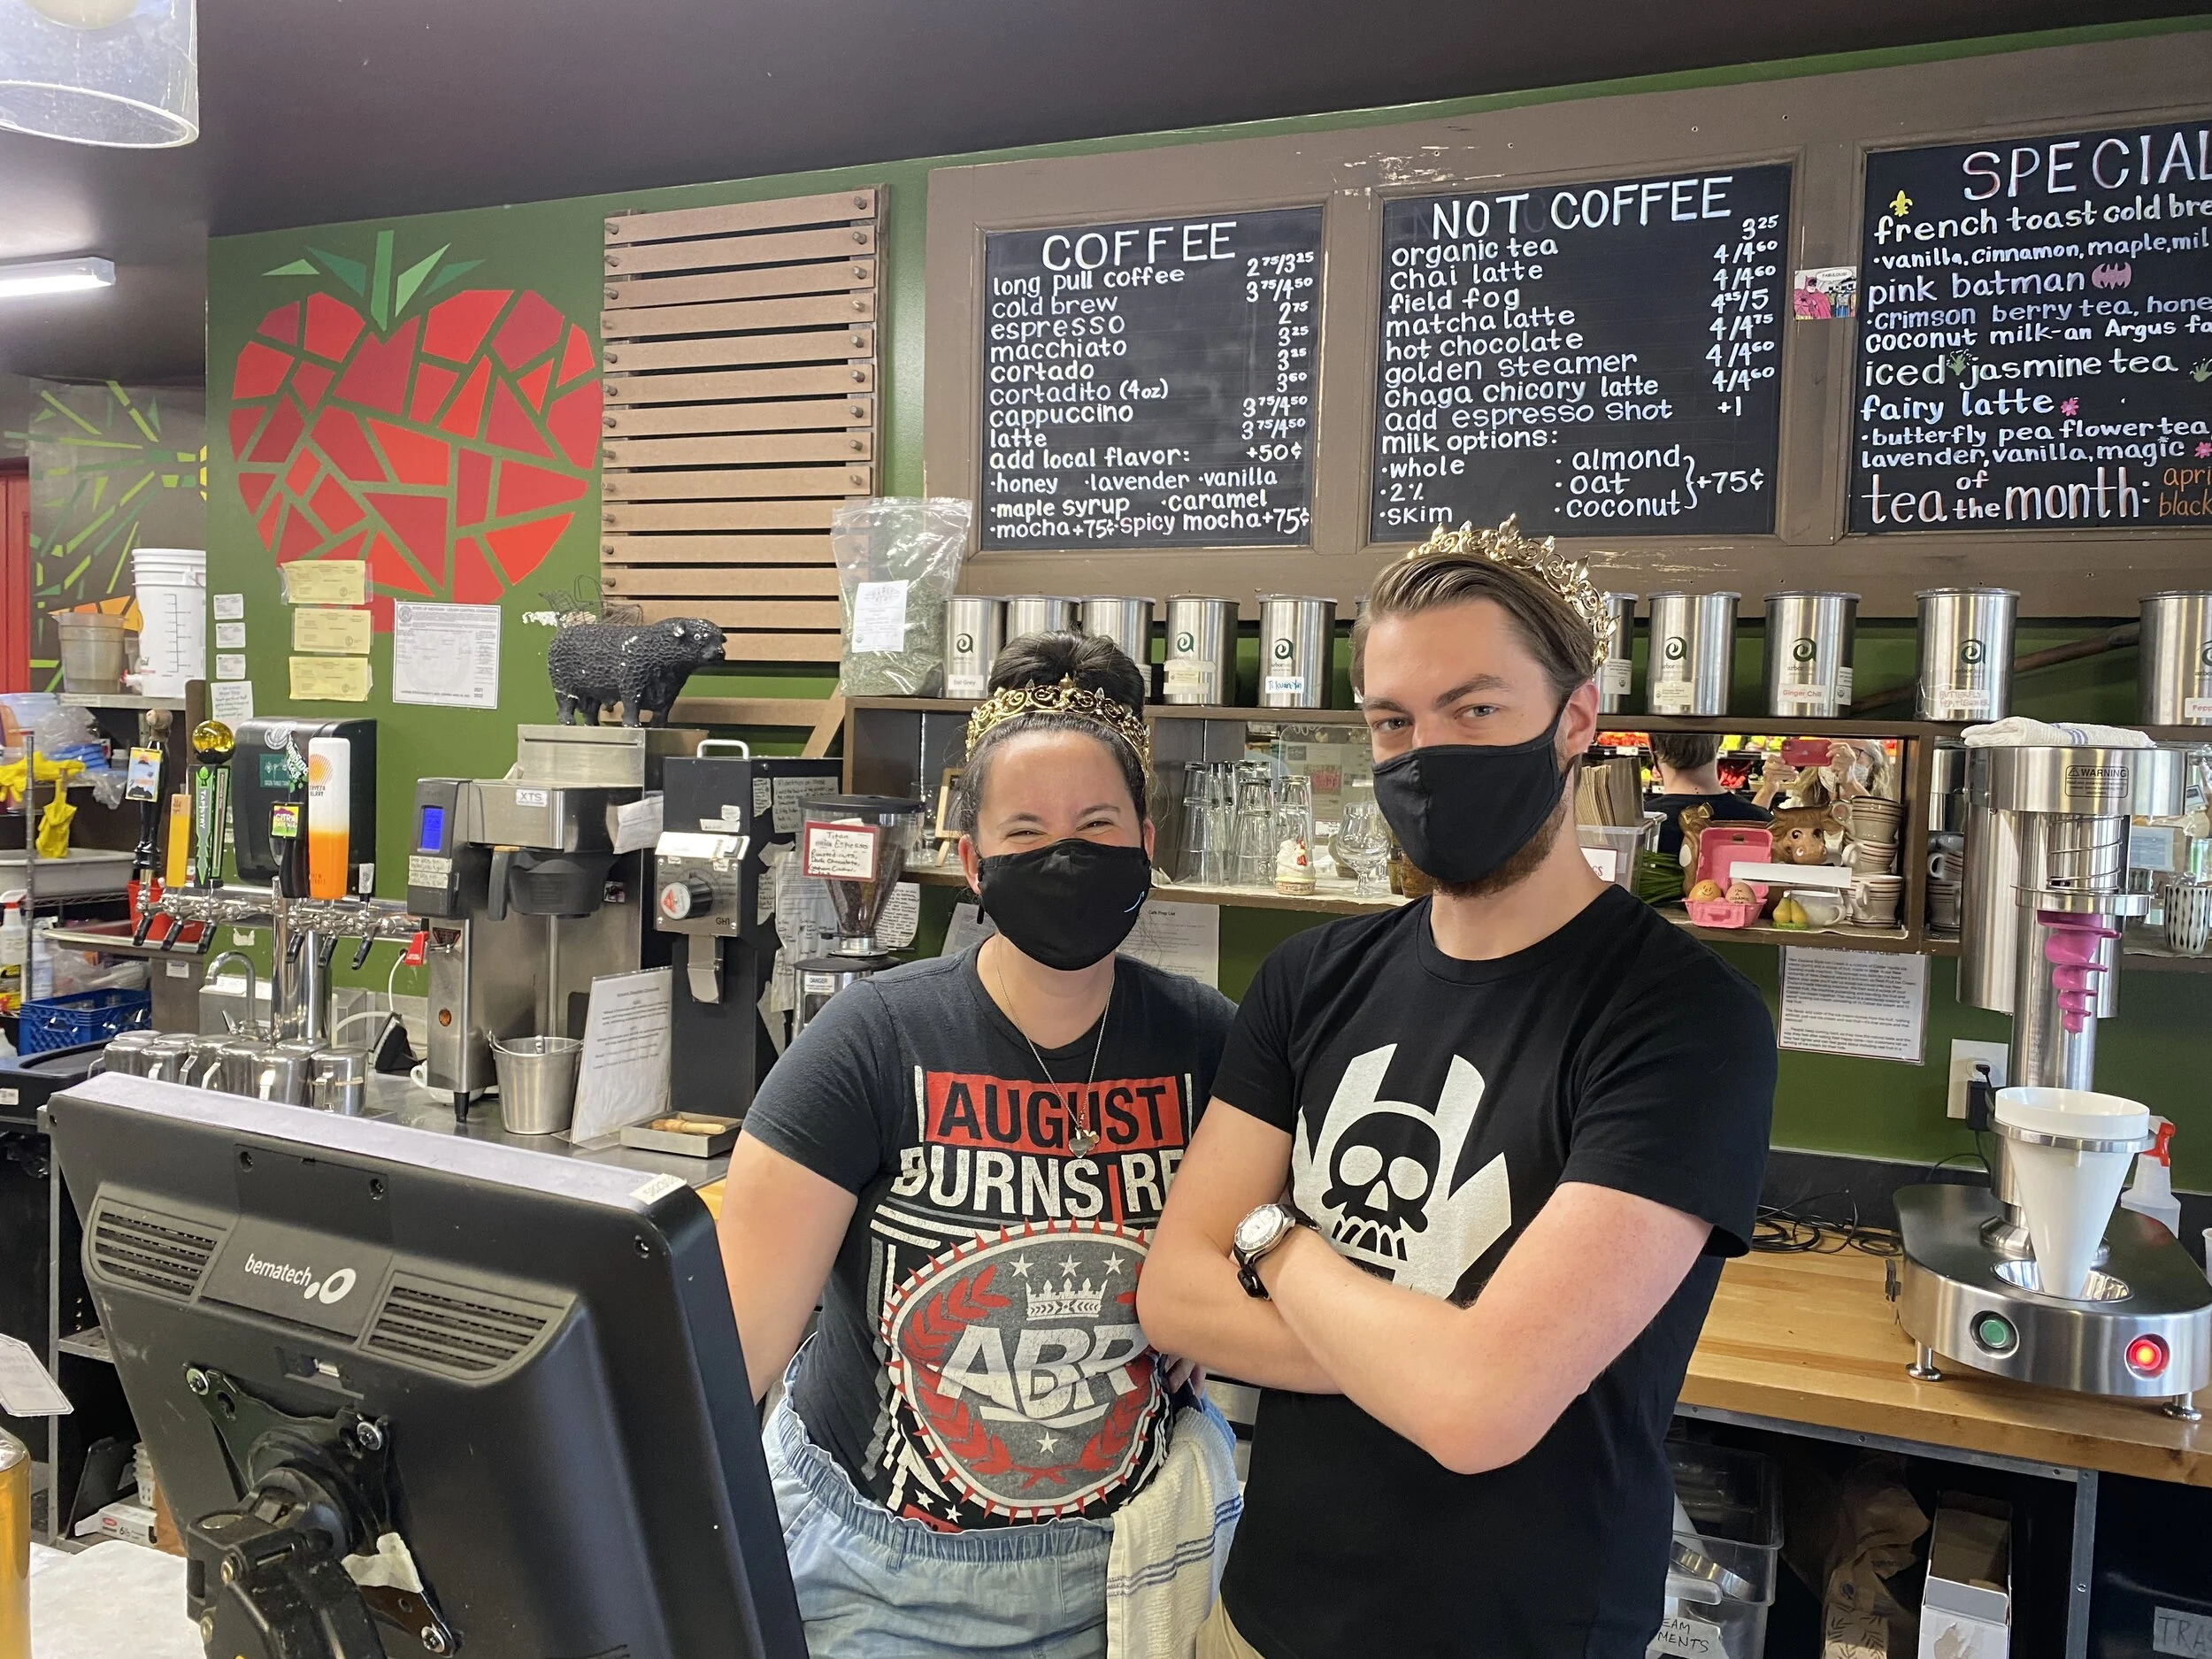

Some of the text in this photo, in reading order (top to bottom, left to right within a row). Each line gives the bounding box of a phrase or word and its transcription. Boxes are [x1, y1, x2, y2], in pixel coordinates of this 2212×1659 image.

[1433, 176, 1732, 240] NOT COFFEE
[1874, 209, 1997, 244] french
[2006, 200, 2097, 231] toast
[2103, 193, 2160, 225] cold
[1041, 221, 1237, 271] COFFEE
[1391, 240, 1499, 268] organic
[1507, 238, 1558, 257] tea
[993, 275, 1040, 297] long
[1053, 270, 1093, 296] pull
[1103, 268, 1186, 288] coffee
[1390, 268, 1457, 291] chai
[1473, 262, 1543, 284] latte
[1868, 270, 2085, 312] pink batman
[992, 297, 1043, 319] cold
[1051, 296, 1118, 315] brew
[1388, 290, 1452, 314] field
[1463, 288, 1519, 311] fog
[1875, 305, 1976, 330] crimson
[1993, 303, 2071, 324] berry
[991, 315, 1125, 342] espresso
[1386, 311, 1496, 337] matcha
[1505, 307, 1575, 329] latte
[1865, 329, 1977, 353] coconut
[2106, 319, 2176, 343] Argus
[990, 339, 1126, 363] macchiato
[1386, 337, 1431, 362] hot
[1440, 331, 1583, 357] chocolate
[991, 360, 1094, 383] cortado
[1386, 358, 1482, 388] golden
[1500, 352, 1637, 377] steamer
[1865, 349, 2178, 389] iced jasmine tea
[990, 381, 1110, 405] cortadito
[1120, 378, 1168, 400] (4oz)
[1385, 381, 1472, 408] chaga
[1483, 380, 1586, 403] chicory
[1601, 377, 1658, 398] latte
[1861, 388, 2055, 425] fairy latte
[989, 403, 1133, 429] cappuccino
[1386, 396, 1742, 432] add espresso shot +1
[991, 429, 1047, 448] latte
[1381, 430, 1558, 454] milk options:
[1872, 424, 1987, 446] butterfly
[2000, 420, 2055, 447] pea
[2059, 419, 2154, 440] flower
[990, 449, 1033, 470] add
[1043, 448, 1095, 469] local
[1104, 447, 1189, 467] flavor:
[1390, 444, 1679, 478] whole almond
[2097, 434, 2185, 466] magic
[996, 467, 1277, 495] honey lavender vanilla
[1391, 472, 1630, 503] 2% oat
[1862, 466, 2151, 524] tea of the month:
[996, 489, 1268, 521] maple syrup caramel
[1388, 489, 1680, 525] skim coconut
[1120, 517, 1175, 534] spicy
[520, 792, 542, 802] XTS
[937, 1080, 1166, 1148] AUGUST
[890, 1146, 1104, 1218] BURNS
[245, 1253, 311, 1286] bematech
[936, 1323, 1153, 1417] ABR
